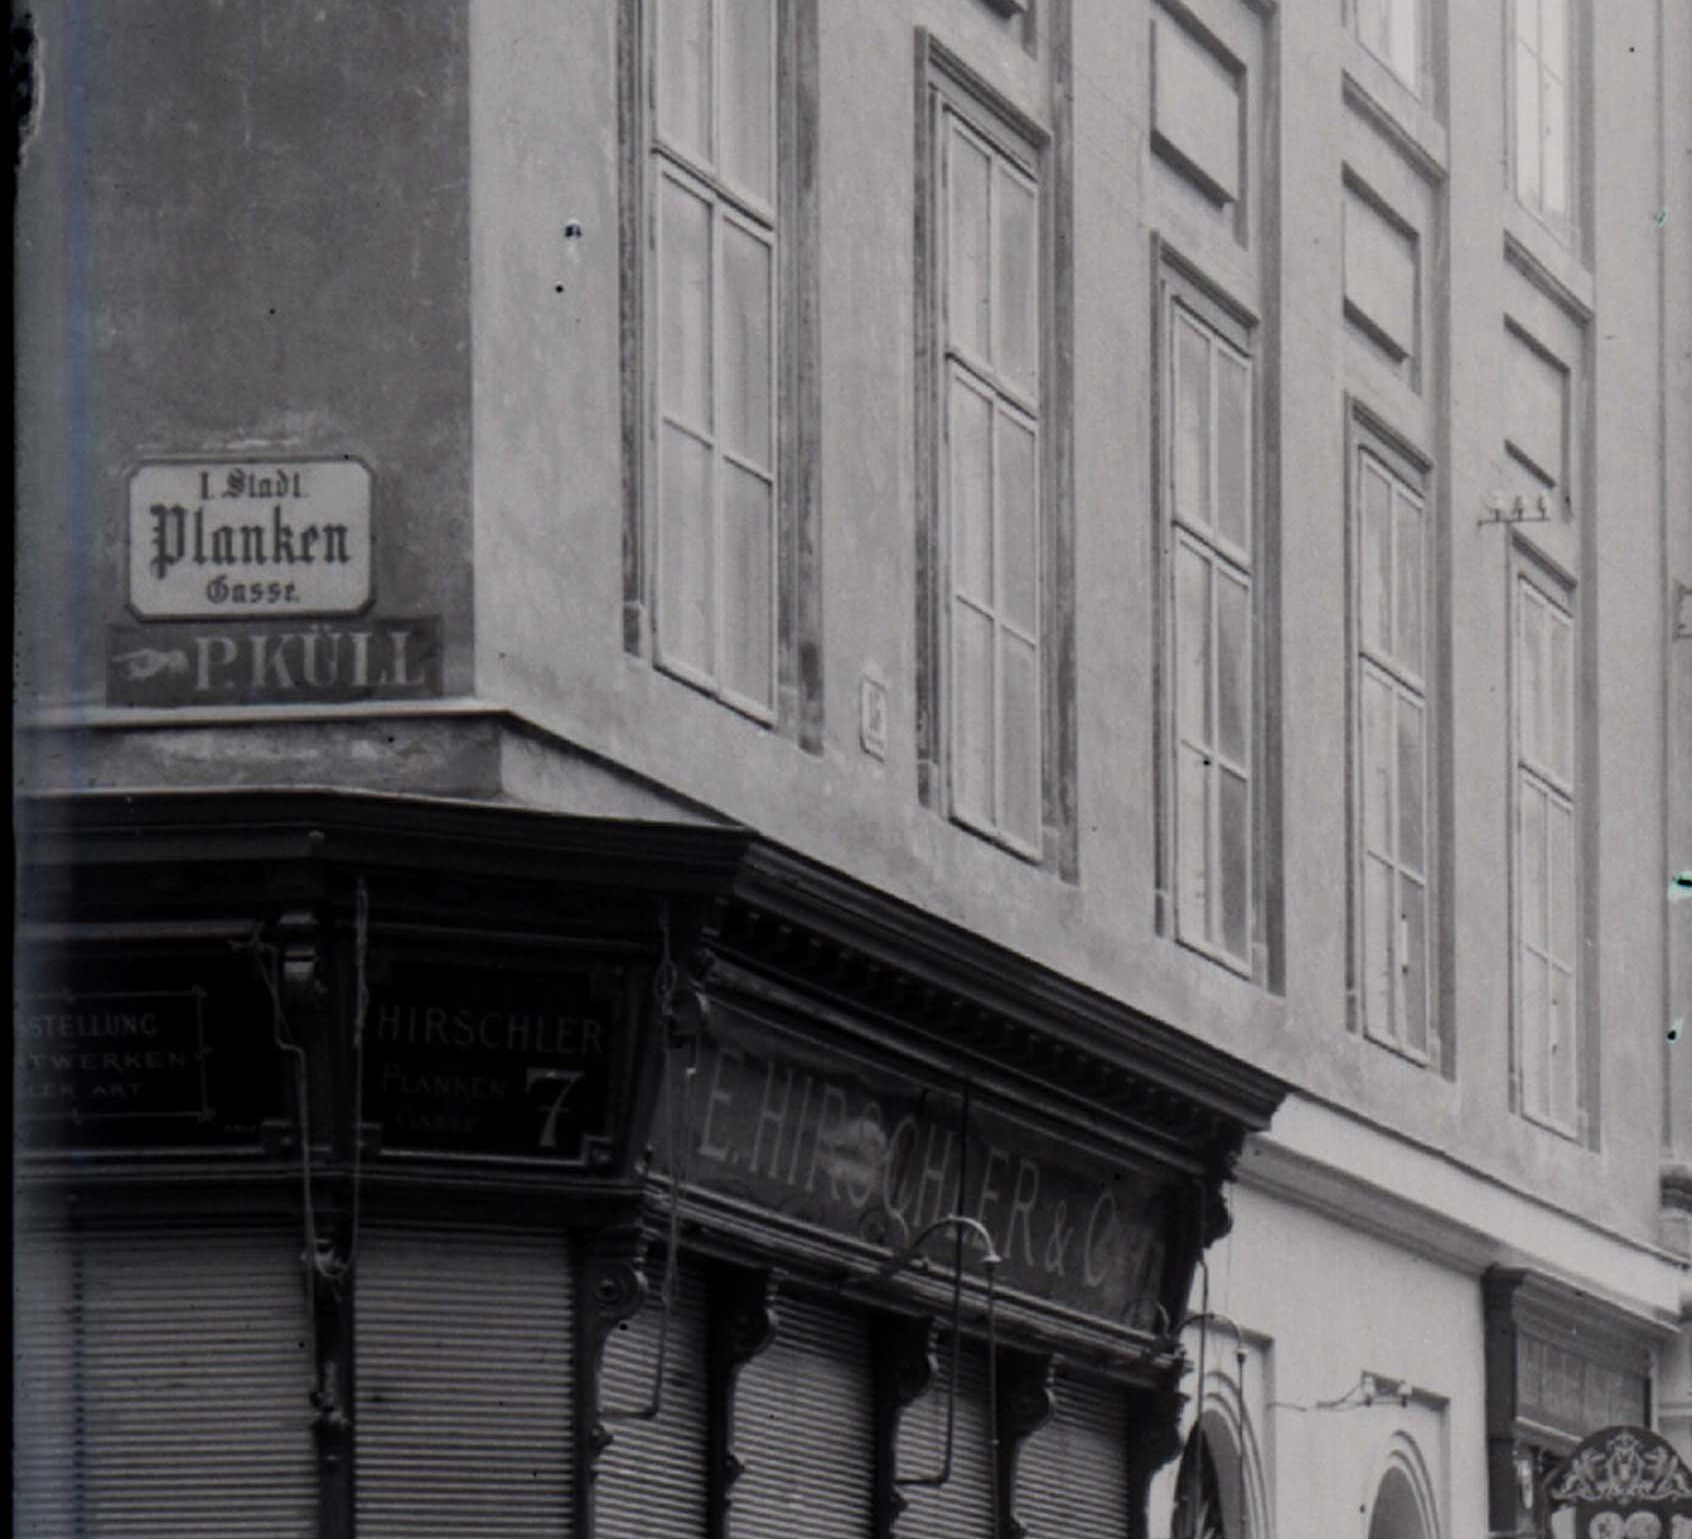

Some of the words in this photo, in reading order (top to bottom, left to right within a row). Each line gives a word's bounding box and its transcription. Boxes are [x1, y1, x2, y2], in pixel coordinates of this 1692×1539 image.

[150, 503, 351, 580] Planken
[376, 998, 604, 1055] HIRSCHLER
[520, 1065, 585, 1149] 7
[1044, 1199, 1073, 1278] &
